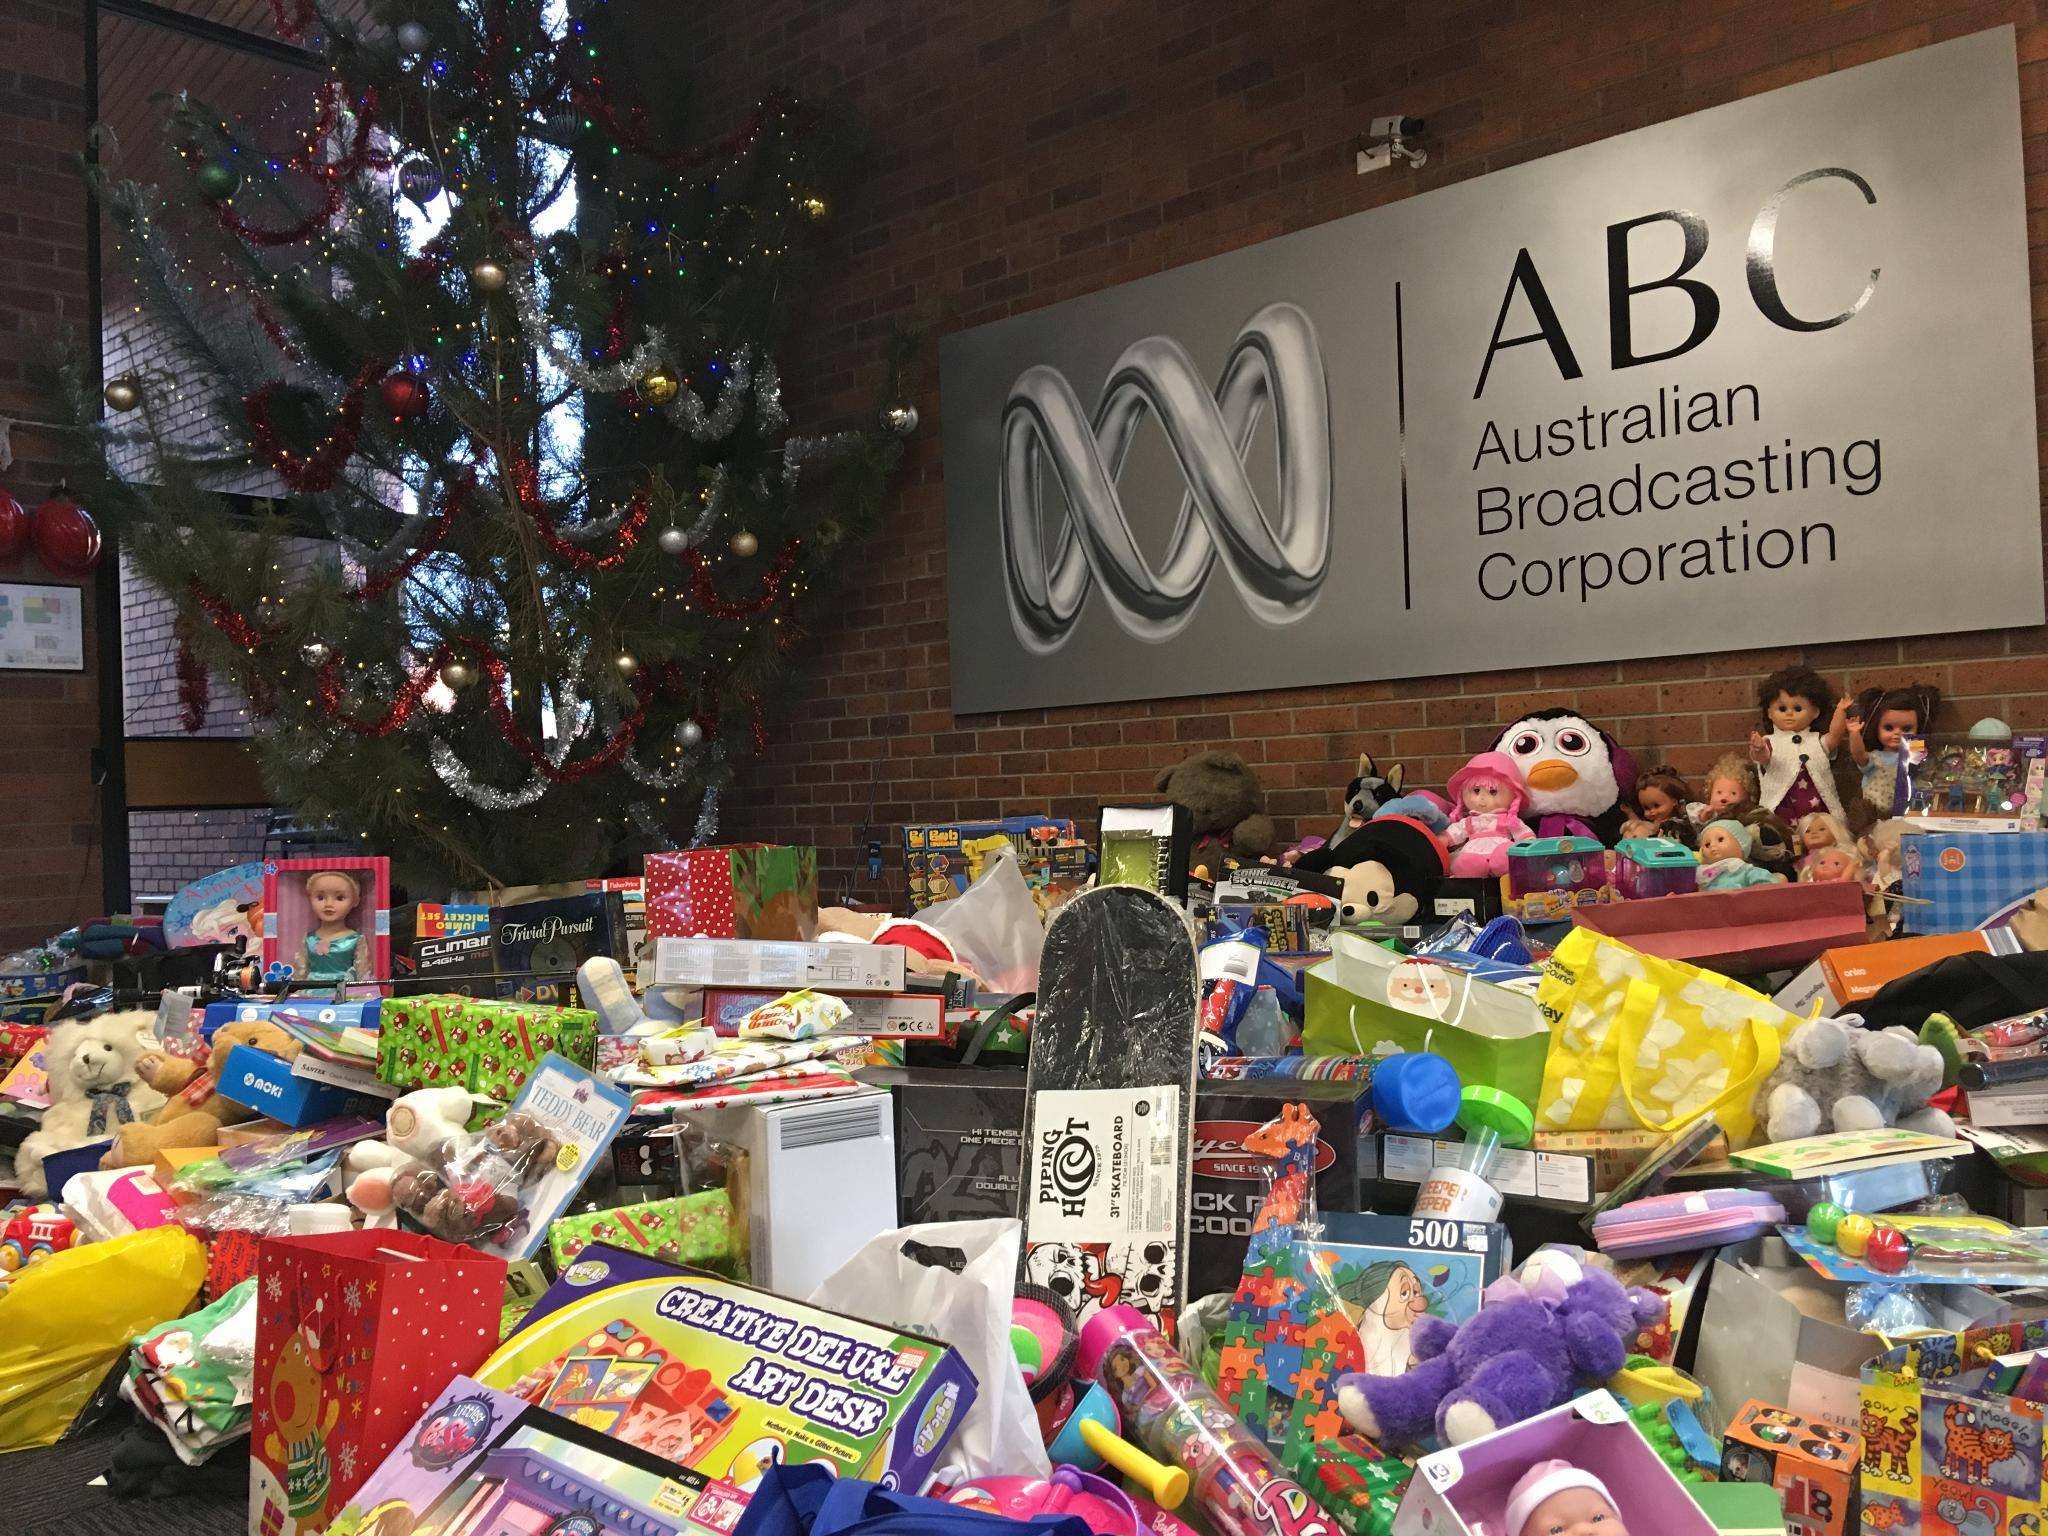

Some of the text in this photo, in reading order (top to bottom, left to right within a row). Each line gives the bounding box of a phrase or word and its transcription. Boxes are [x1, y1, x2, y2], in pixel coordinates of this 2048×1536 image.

[1473, 167, 1881, 400] ABC
[1473, 383, 1760, 471] Australian
[1476, 437, 1882, 536] Broadcasting
[1478, 520, 1836, 603] Corporation
[435, 921, 476, 931] JUMBO
[443, 912, 490, 922] CRICKET
[501, 921, 547, 946] Trivial
[543, 915, 595, 945] Pursuit
[531, 1085, 607, 1142] TEDDY BEAR
[960, 1136, 1016, 1146] ONE PIECE
[1039, 1128, 1064, 1205] PIPING
[1052, 1116, 1096, 1218] HOT
[1112, 1115, 1124, 1199] SKATEBOARD
[1213, 1162, 1246, 1174] SINCE
[1407, 1219, 1460, 1249] 500
[657, 1287, 915, 1393] CREATIVE DELUXE
[729, 1358, 886, 1435] ART DESK
[765, 1419, 786, 1433] Method
[793, 1430, 810, 1443] Make
[832, 1446, 853, 1460] Picture
